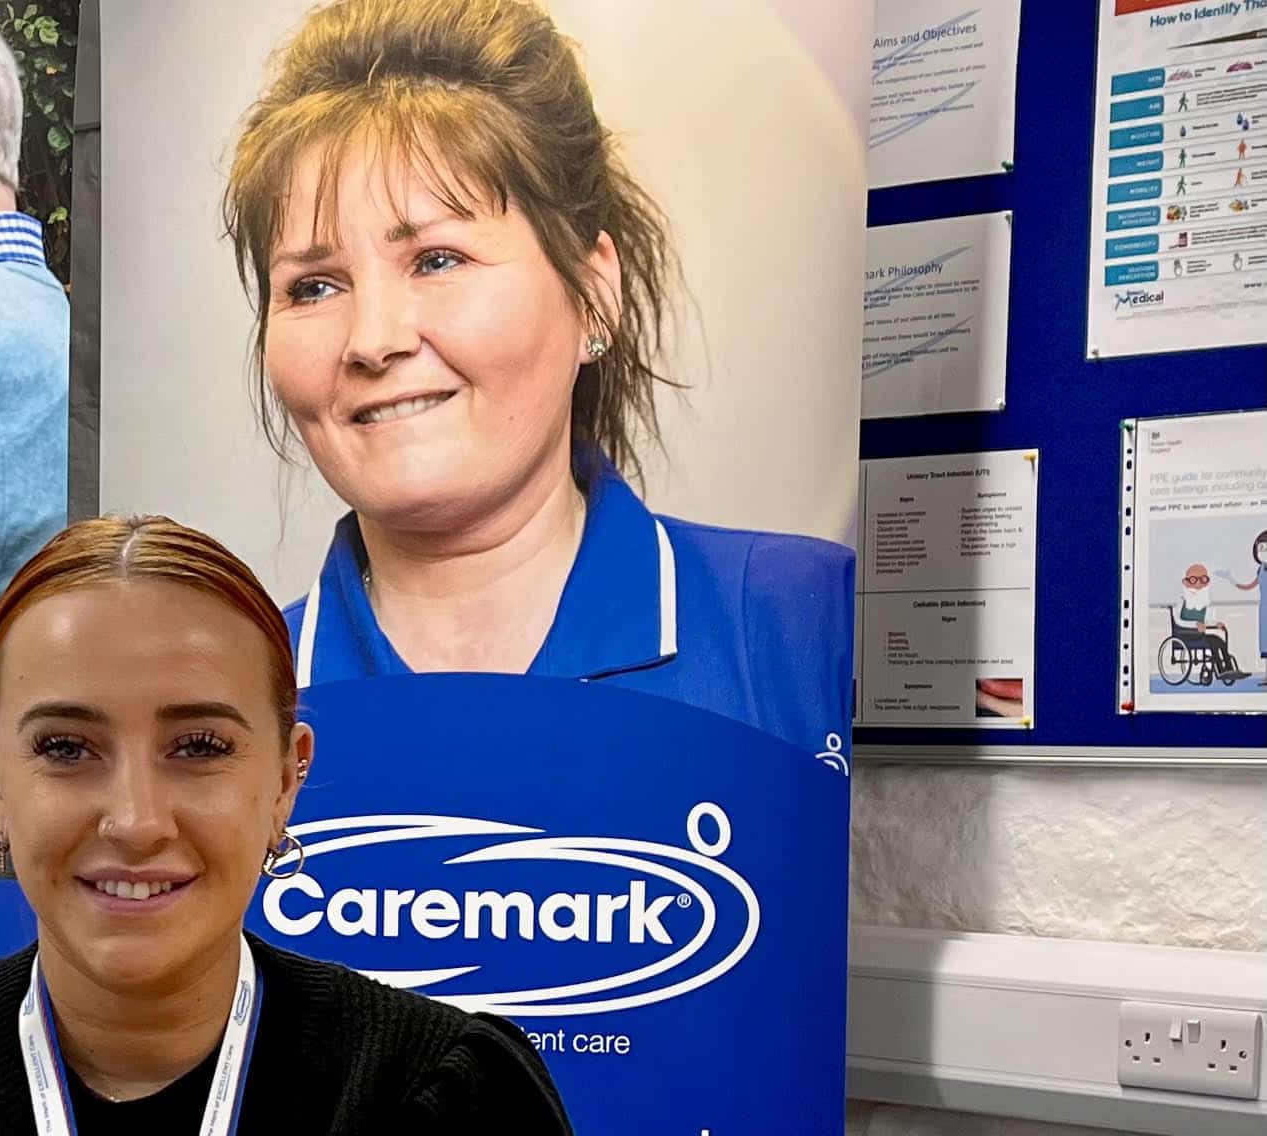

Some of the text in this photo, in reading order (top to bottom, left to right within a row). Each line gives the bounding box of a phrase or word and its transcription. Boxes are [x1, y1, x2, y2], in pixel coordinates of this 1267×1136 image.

[1150, 15, 1177, 28] How
[1180, 11, 1192, 22] to
[873, 23, 977, 49] Aims and Objectives
[887, 261, 943, 278] Philosophy
[521, 1026, 630, 1054] ent care
